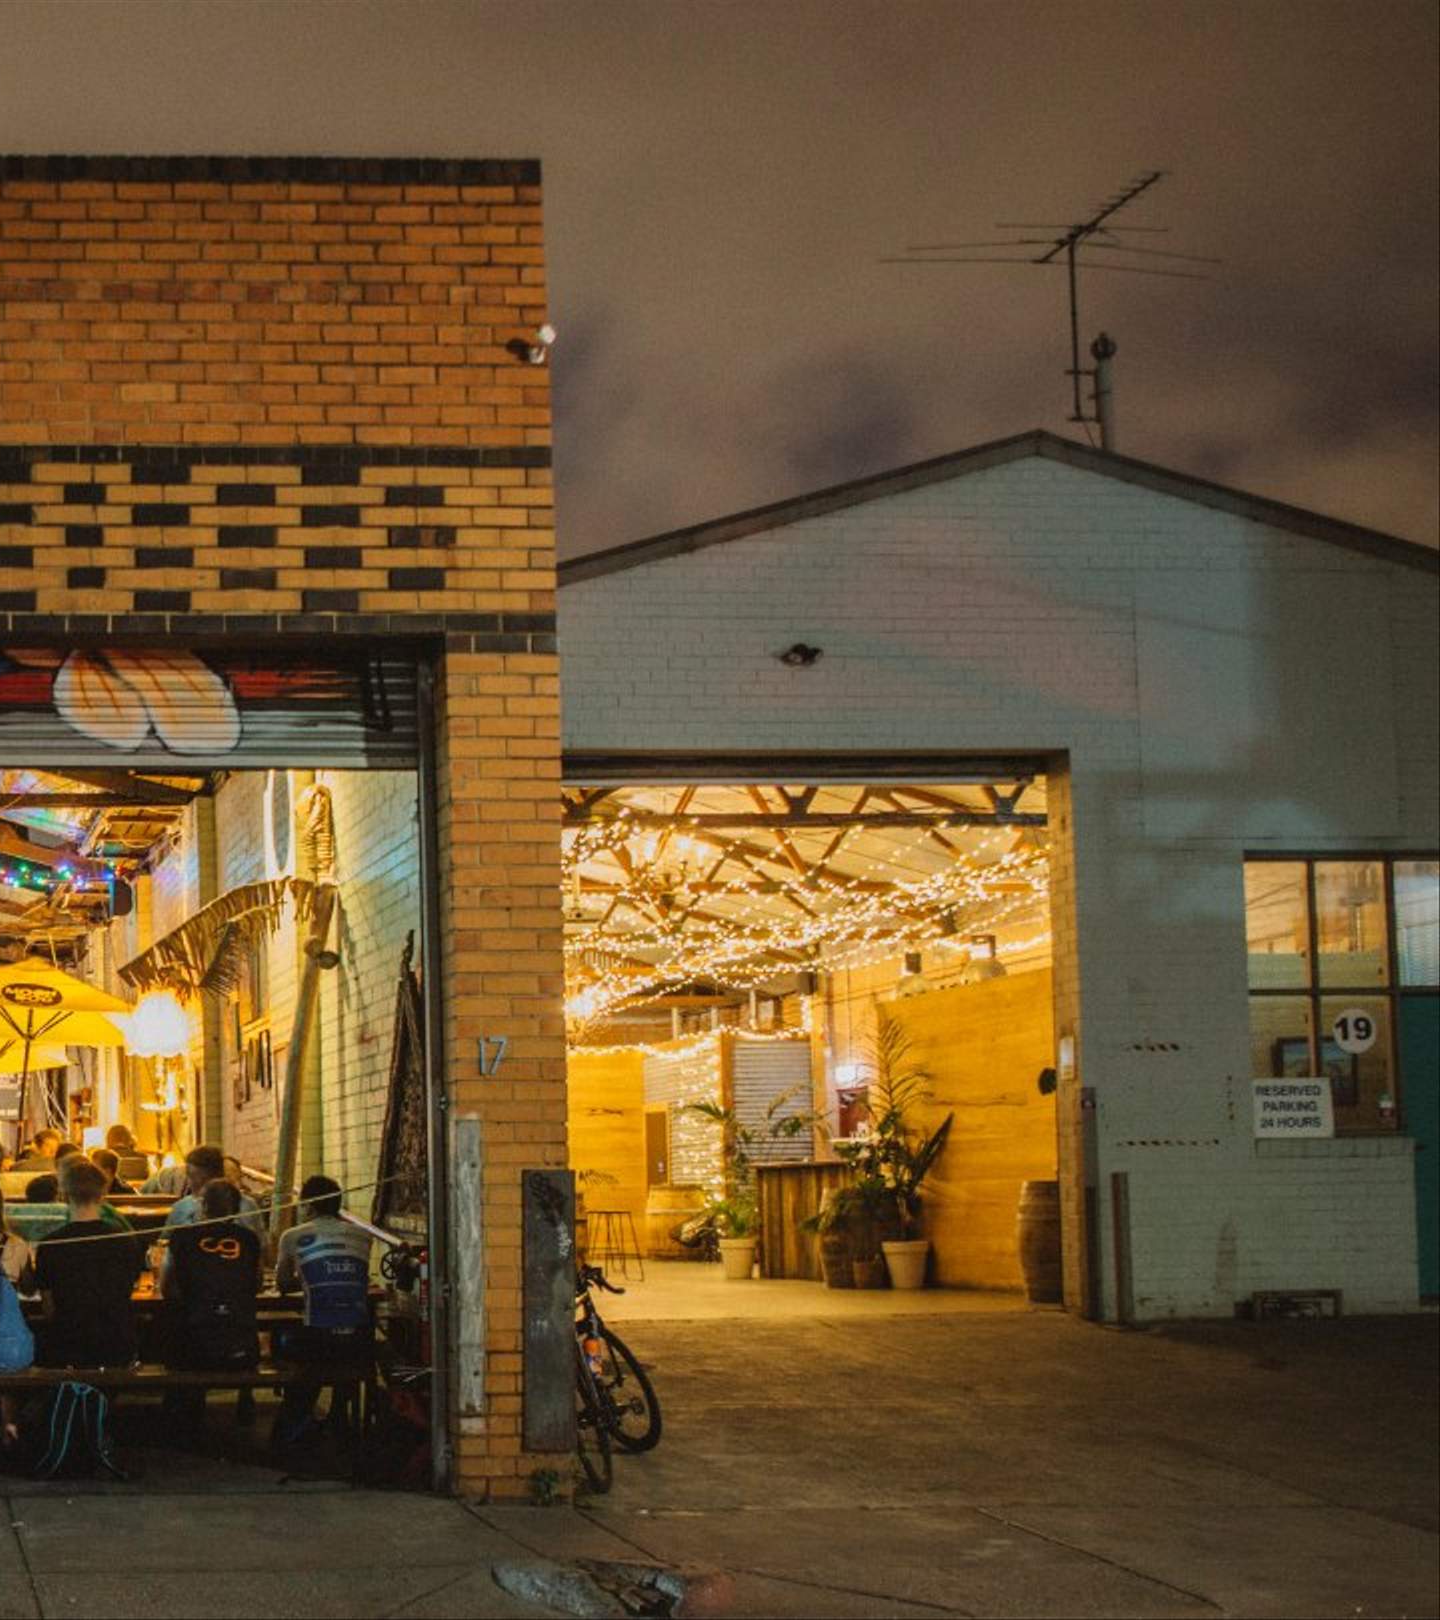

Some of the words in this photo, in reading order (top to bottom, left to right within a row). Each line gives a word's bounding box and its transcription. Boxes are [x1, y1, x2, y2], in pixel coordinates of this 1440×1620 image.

[1335, 1017, 1372, 1041] 19
[479, 1035, 507, 1076] 17
[1255, 1085, 1321, 1097] RESERVED
[1263, 1101, 1318, 1112] PARKING
[1261, 1118, 1274, 1128] 24
[1277, 1117, 1322, 1128] HOURS
